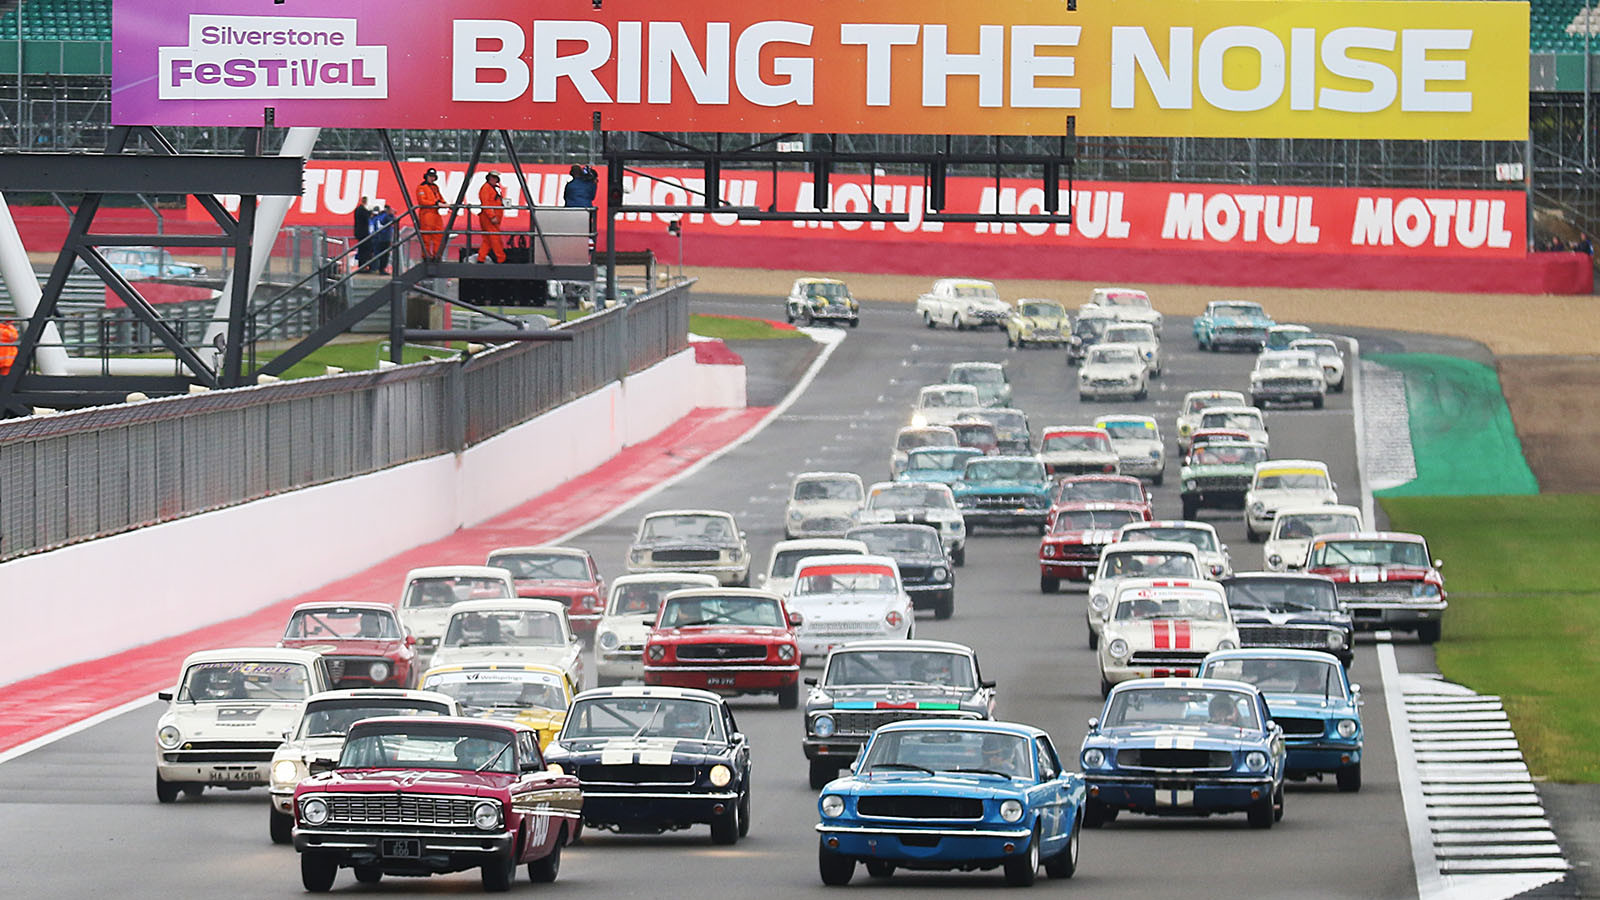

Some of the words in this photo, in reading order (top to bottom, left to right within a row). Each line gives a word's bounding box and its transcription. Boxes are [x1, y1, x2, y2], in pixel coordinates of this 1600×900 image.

[201, 25, 345, 46] Silverstone
[452, 20, 814, 106] BRING
[841, 23, 1082, 108] THE
[1111, 26, 1473, 112] NOISE
[975, 187, 1131, 239] MOTUL
[1162, 192, 1319, 244] MOTUL
[1352, 197, 1511, 247] MOTUL
